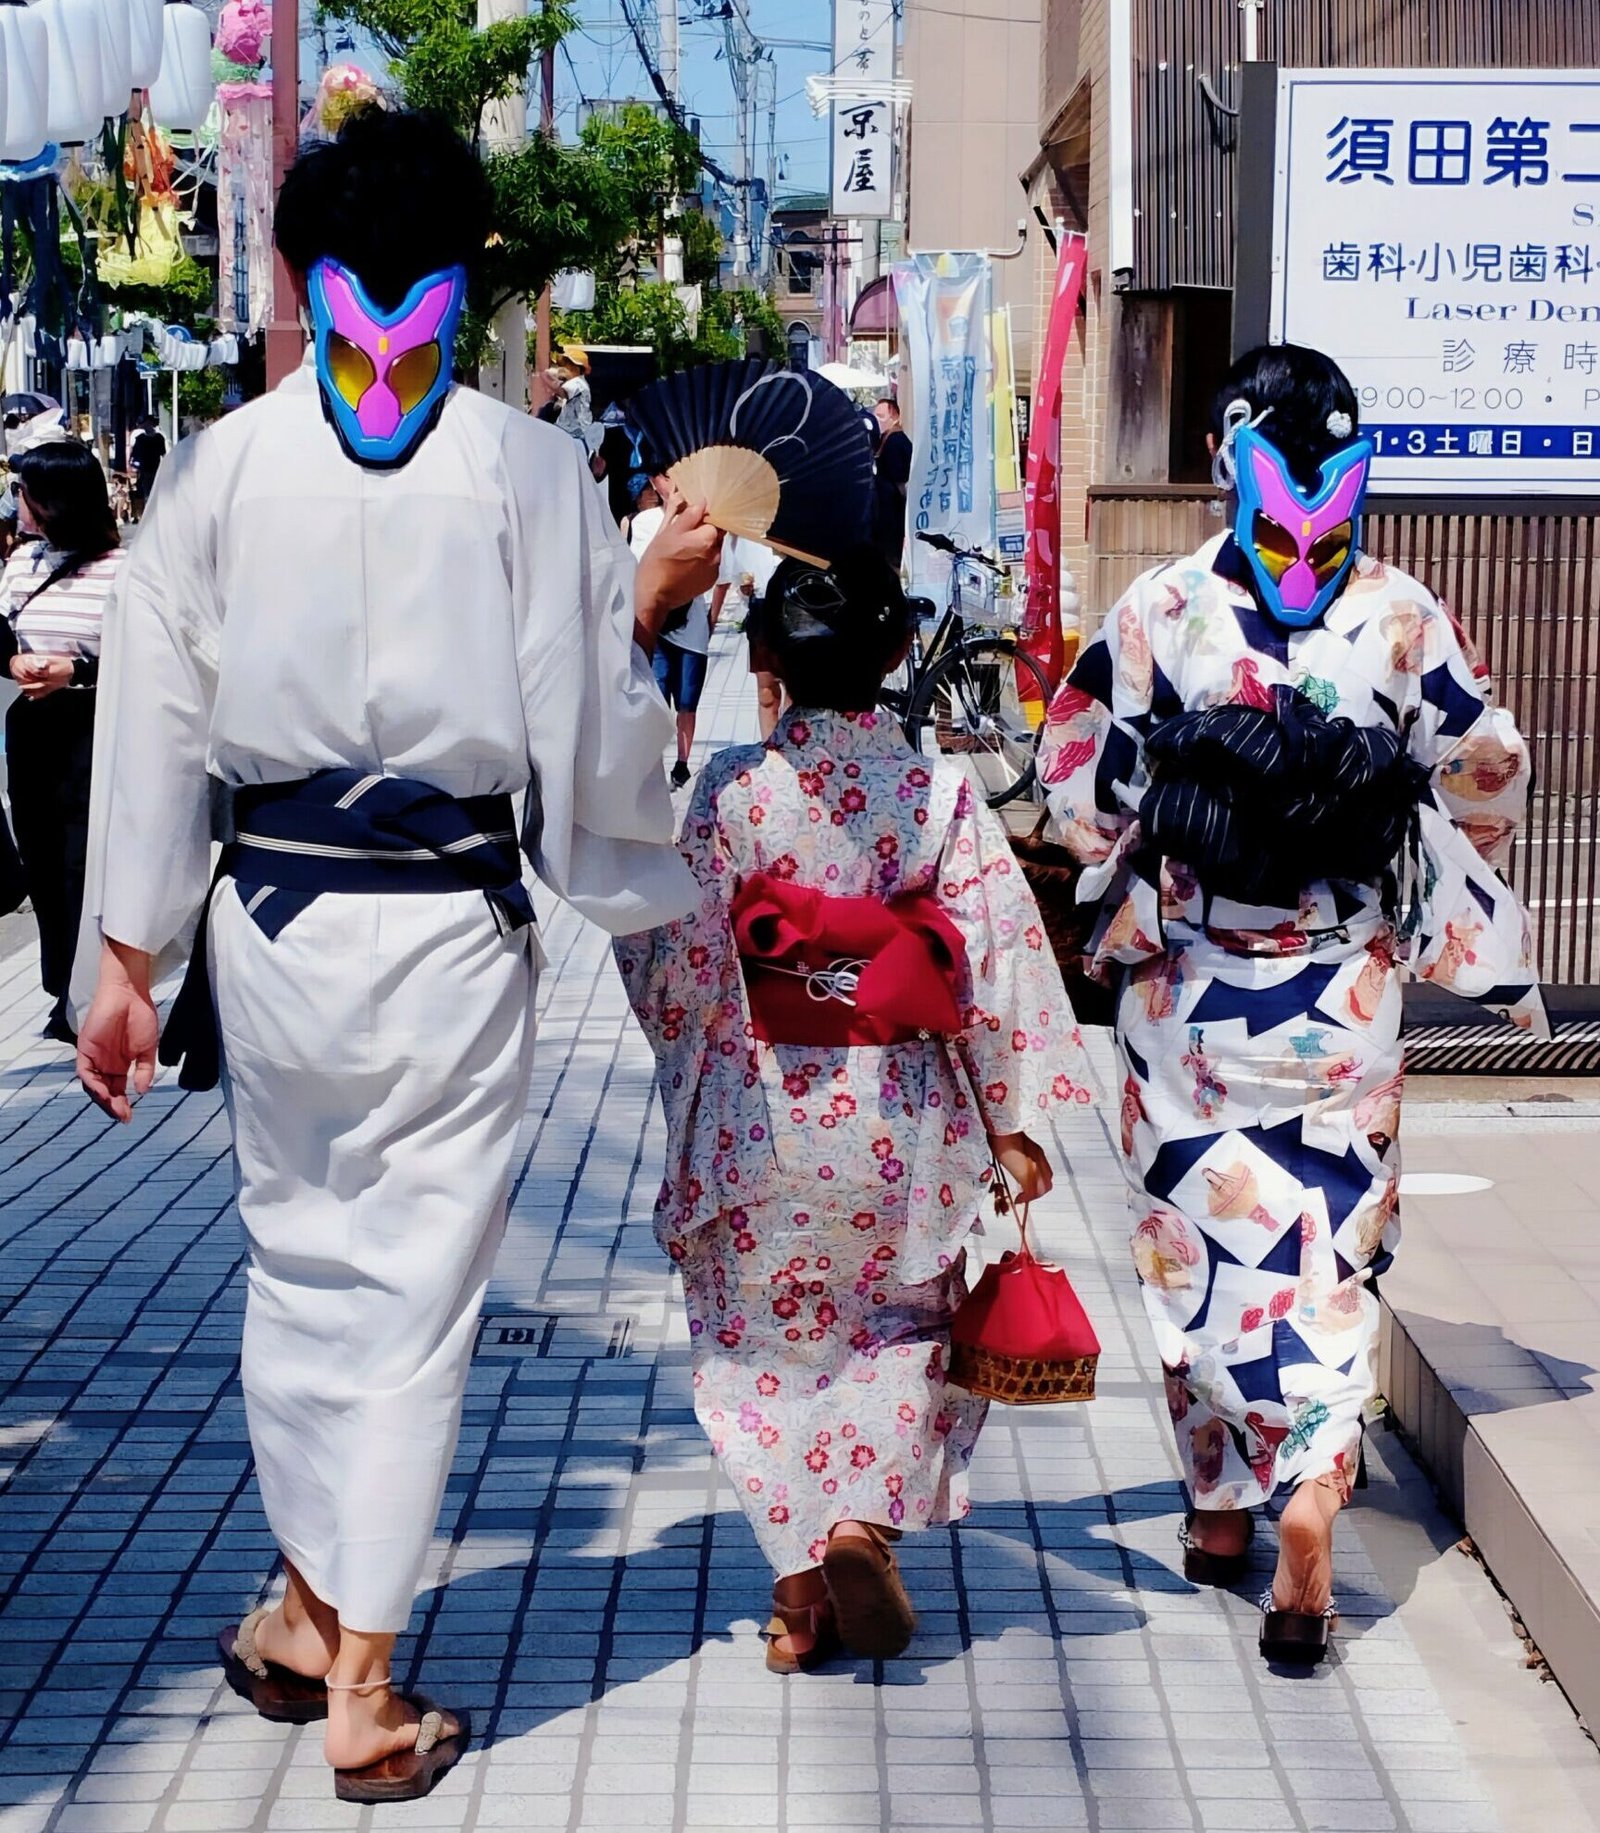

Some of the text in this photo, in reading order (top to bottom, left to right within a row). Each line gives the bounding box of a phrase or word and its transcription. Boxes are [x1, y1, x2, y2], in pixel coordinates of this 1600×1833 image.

[838, 92, 887, 193] 京屋
[1325, 115, 1600, 188] 須田第二
[1572, 202, 1600, 227] S
[1405, 297, 1600, 322] Laser Den
[1442, 338, 1599, 375] 診療時
